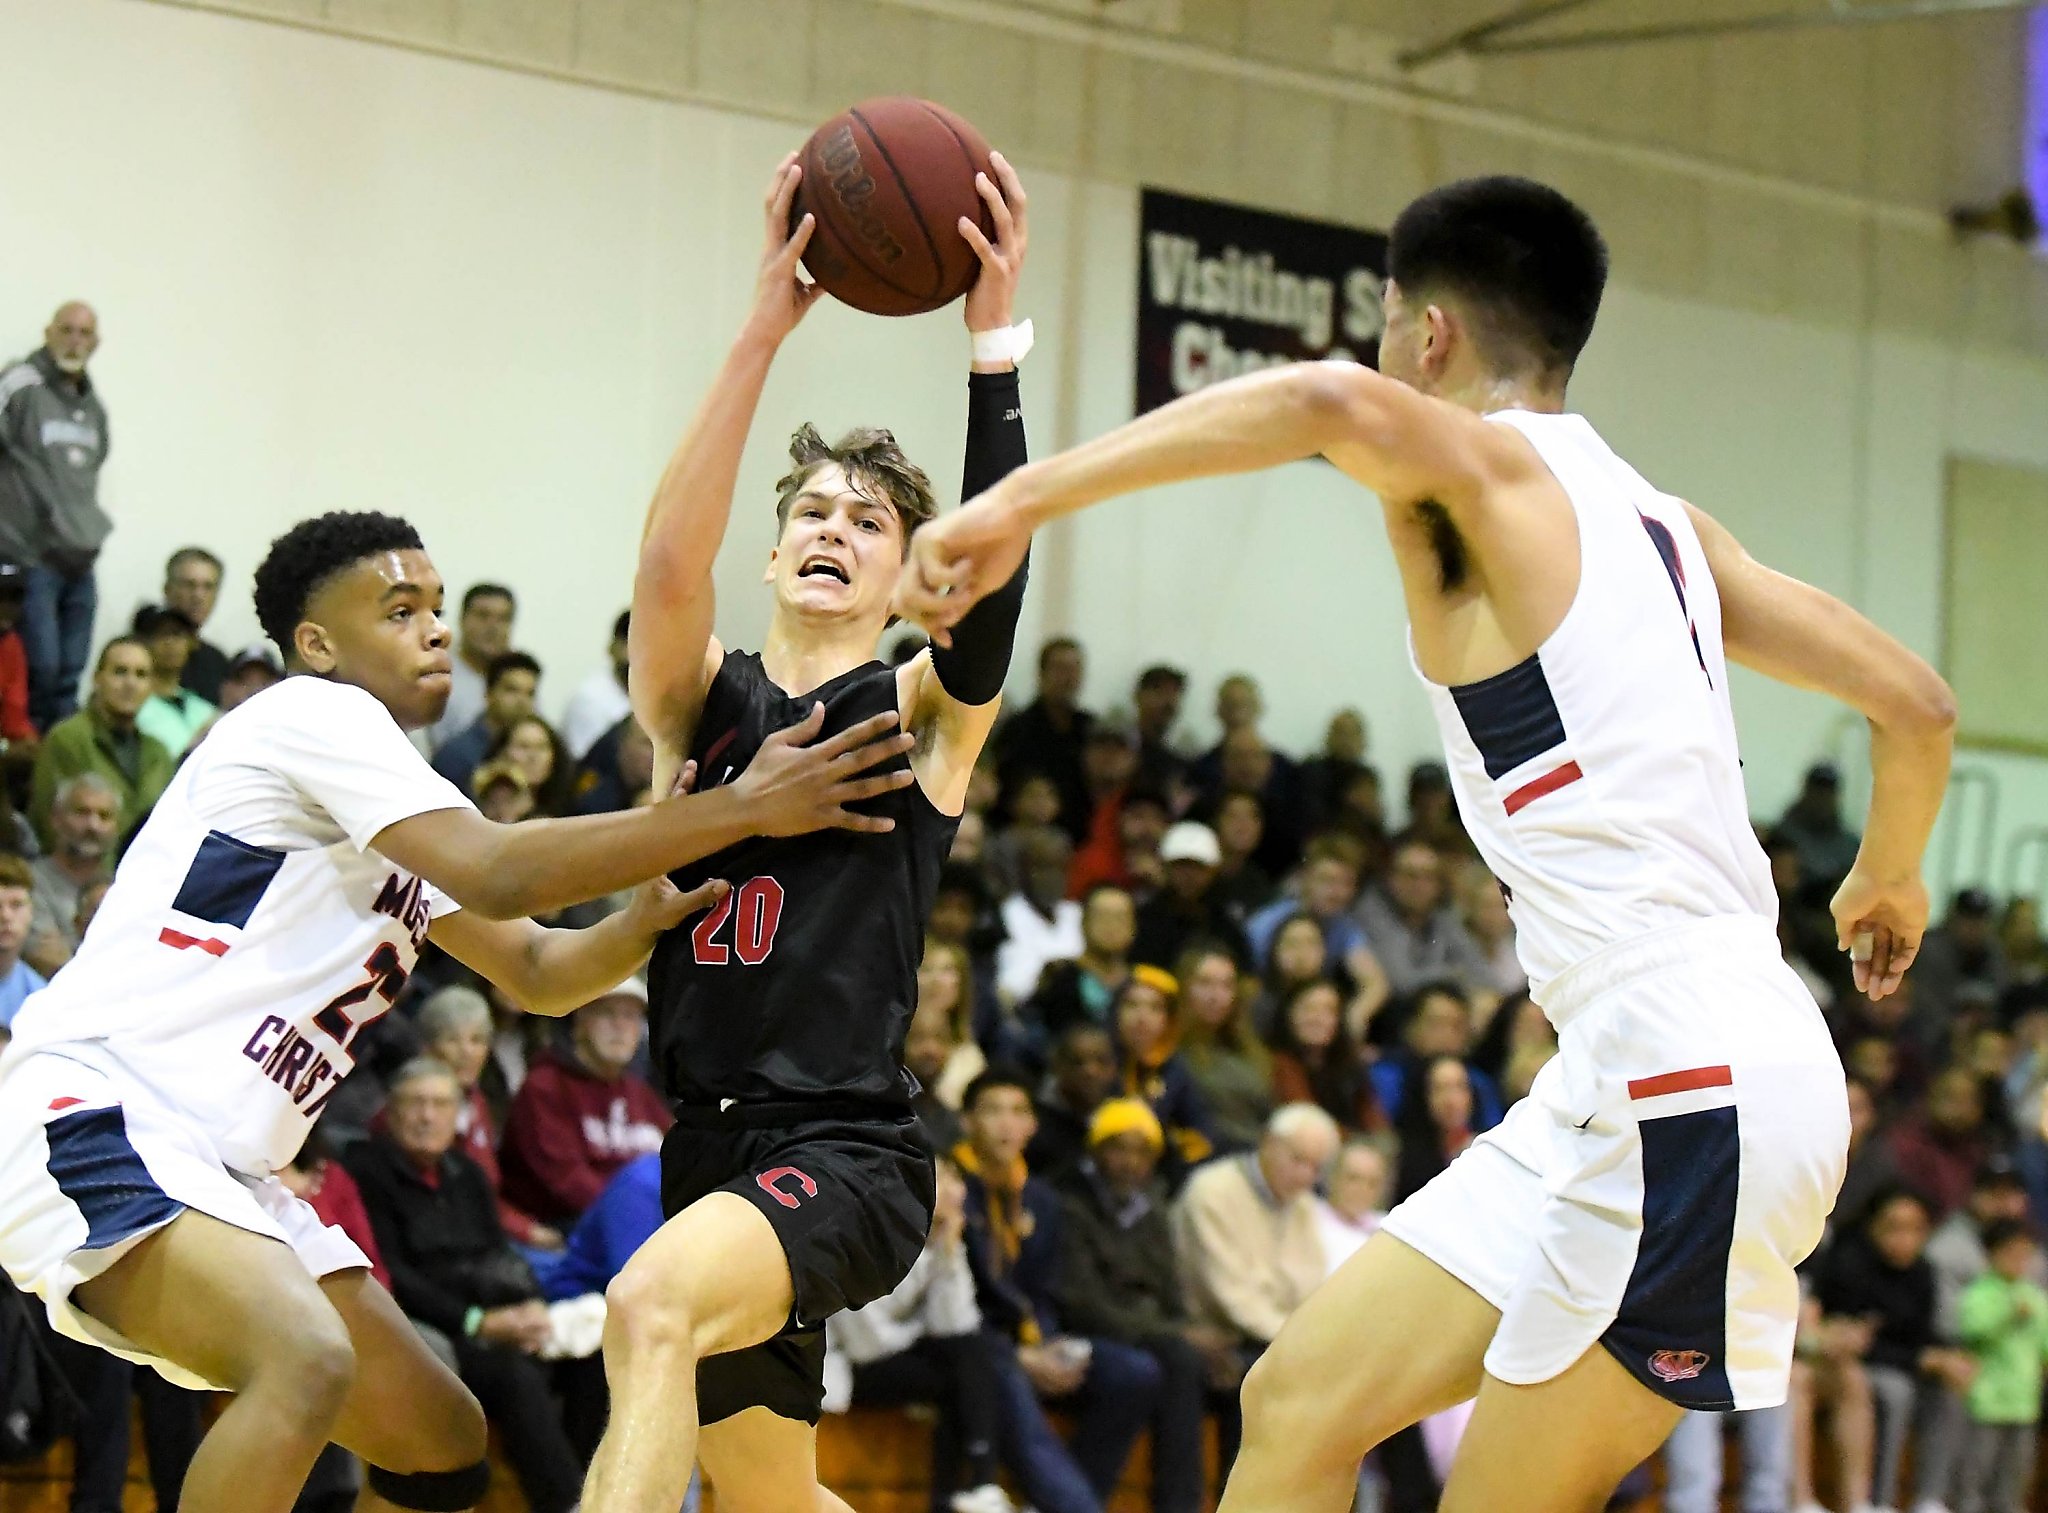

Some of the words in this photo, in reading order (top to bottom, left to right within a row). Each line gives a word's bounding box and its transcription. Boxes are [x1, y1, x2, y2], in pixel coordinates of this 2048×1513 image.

[1148, 230, 1334, 350] Visiting
[1342, 266, 1386, 342] S
[691, 875, 785, 966] 20
[755, 1165, 818, 1209] C
